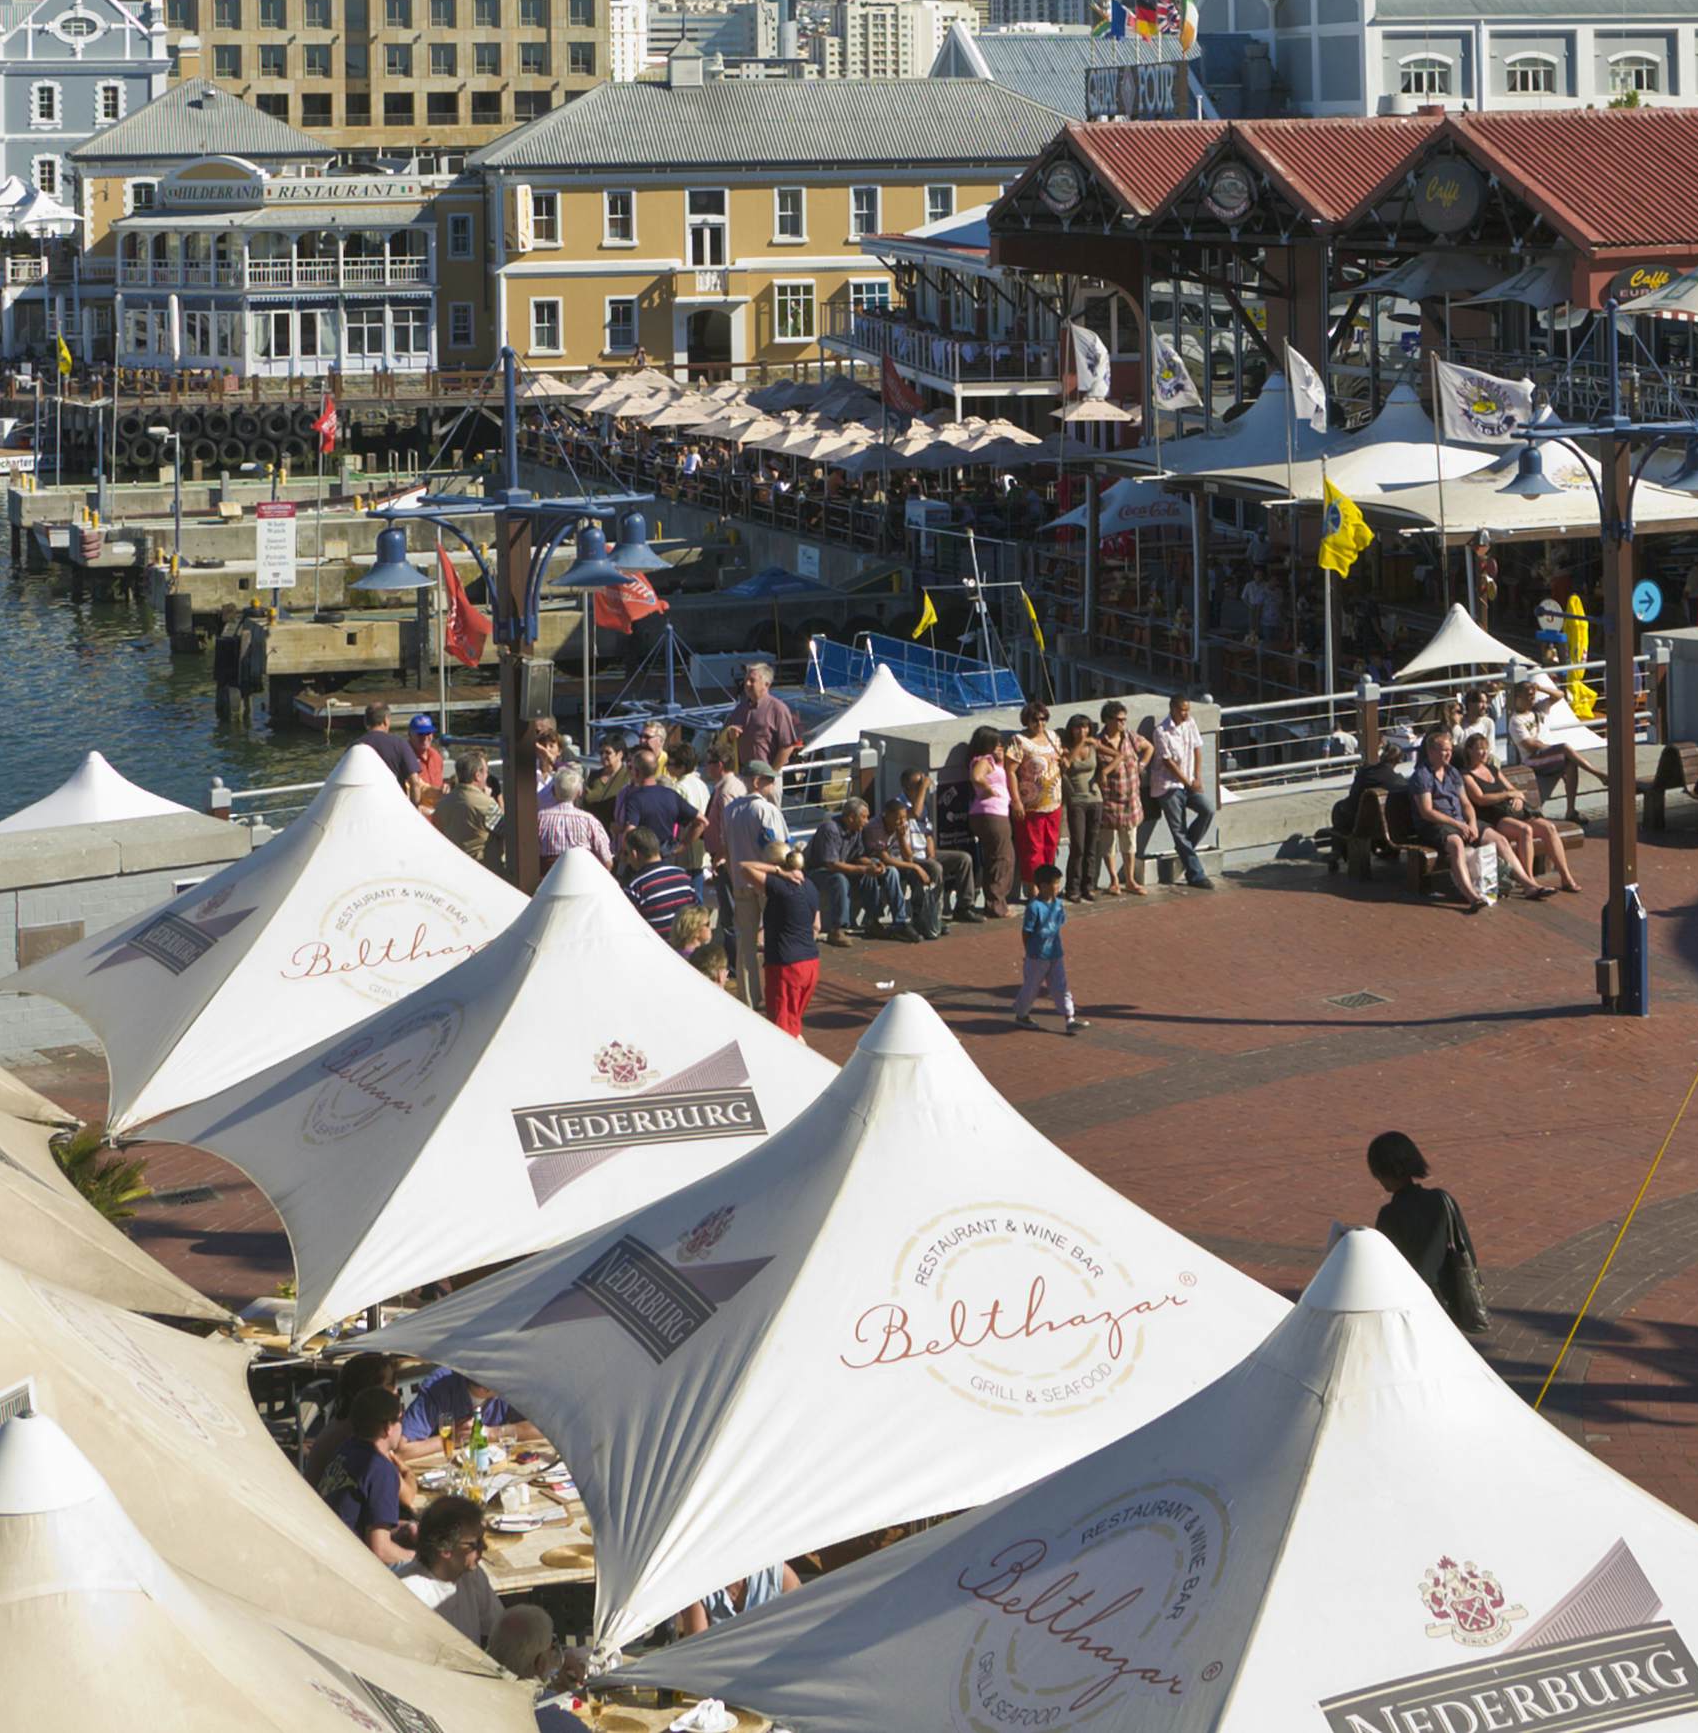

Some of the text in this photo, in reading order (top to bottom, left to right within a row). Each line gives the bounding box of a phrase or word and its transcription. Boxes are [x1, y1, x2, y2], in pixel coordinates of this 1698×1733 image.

[1137, 67, 1175, 113] FOUR
[178, 183, 395, 201] HILDEBRAND RESTAURANT
[336, 887, 469, 932] RESTAURANT & WINE BAR
[525, 1100, 752, 1148] NEDERBURG
[915, 1219, 1104, 1288] RESTAURANT & WINE BAR
[588, 1246, 695, 1346] NEDERBURG
[840, 1276, 1188, 1368] Belthazar
[970, 1362, 1112, 1403] GRILL & SEAFOOD
[1081, 1500, 1208, 1620] RESTAURANT & WINE BAR
[958, 1538, 1183, 1713] Belthazar
[1343, 1649, 1690, 1733] NEDERBURG
